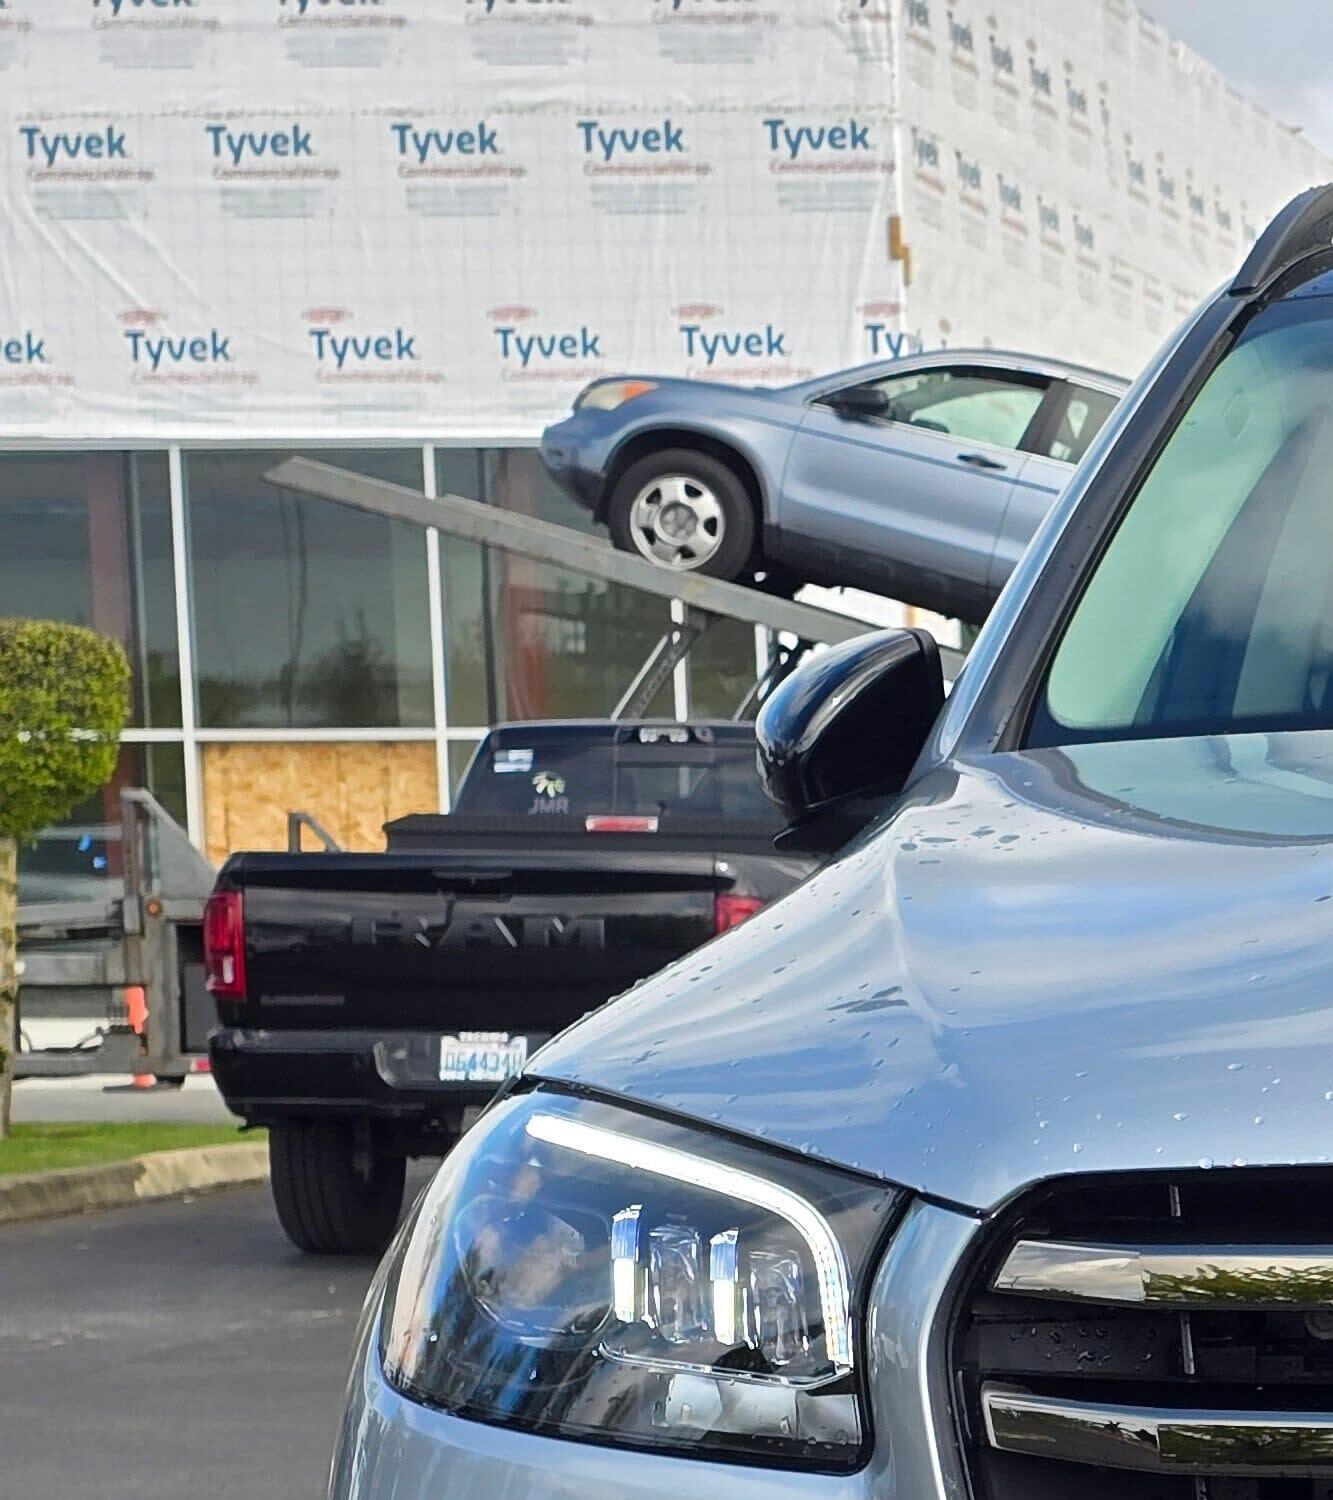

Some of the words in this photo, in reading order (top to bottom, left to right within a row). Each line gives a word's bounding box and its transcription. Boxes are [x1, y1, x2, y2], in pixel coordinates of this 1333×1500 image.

[20, 124, 127, 168] Tyvek
[205, 124, 312, 165] Tyvek
[391, 121, 498, 163] Tyvek
[577, 120, 685, 161] Tyvek
[763, 118, 870, 158] Tyvek
[124, 328, 230, 370] Tyvek
[309, 327, 416, 368] Tyvek
[495, 326, 601, 366] Tyvek
[680, 323, 785, 364] Tyvek
[350, 916, 605, 948] RAM
